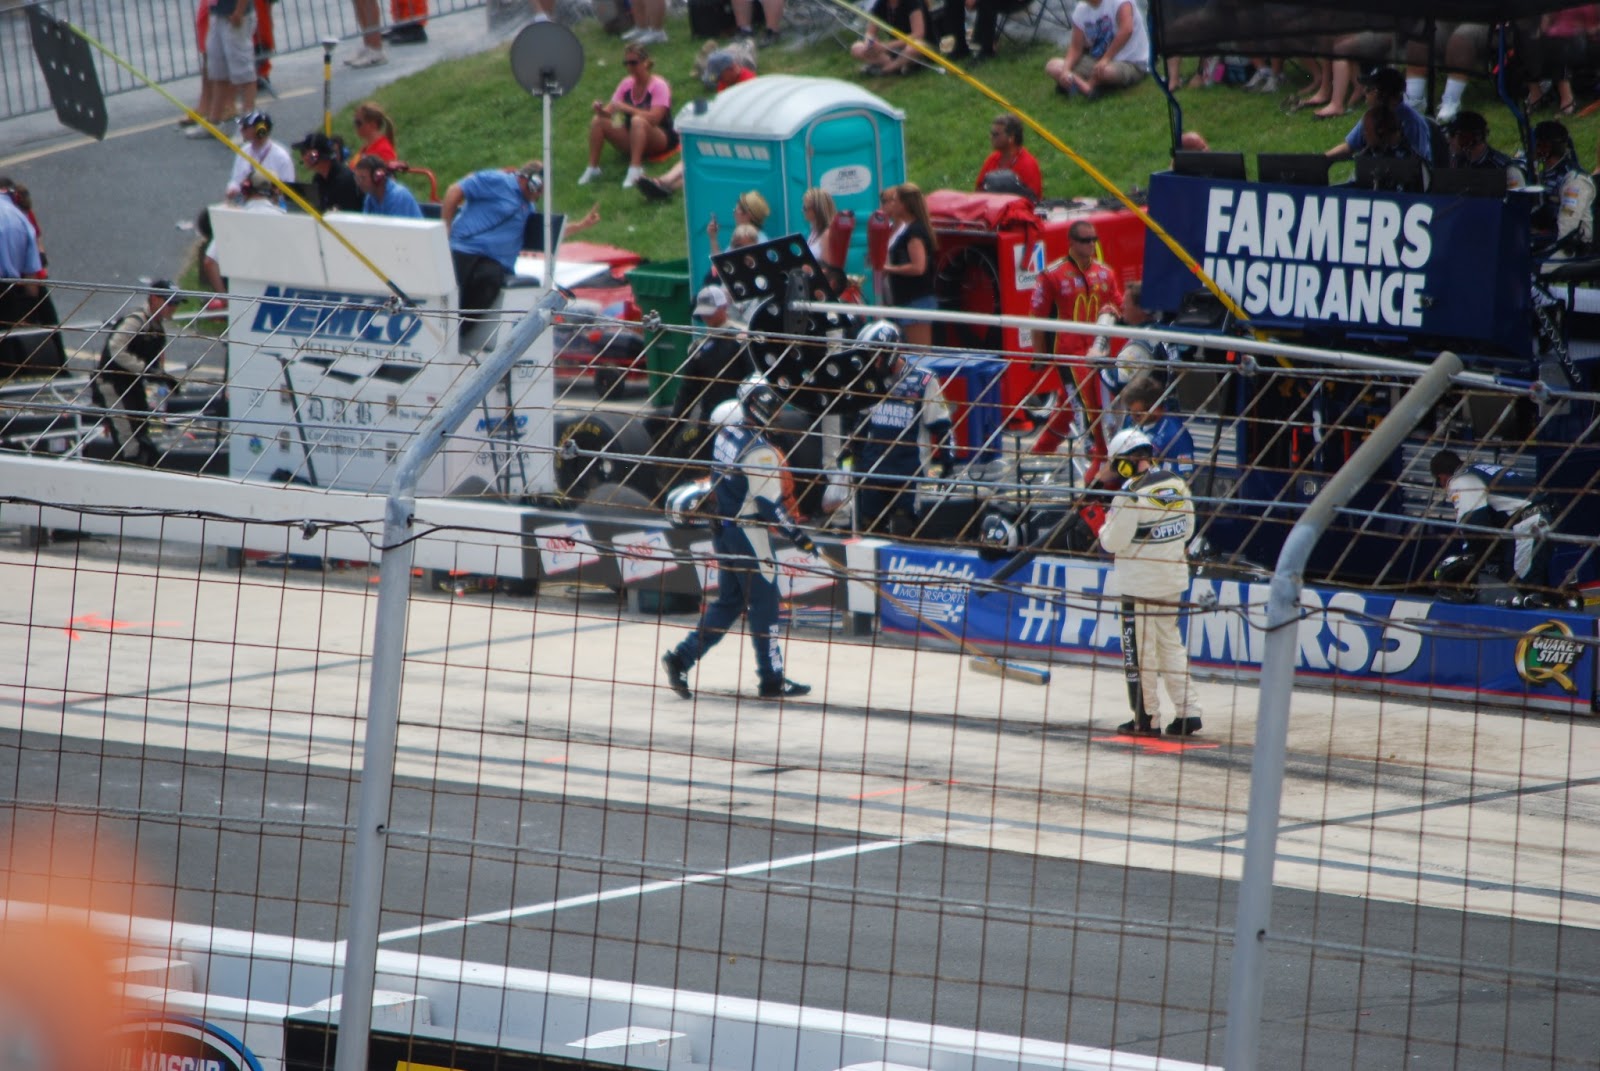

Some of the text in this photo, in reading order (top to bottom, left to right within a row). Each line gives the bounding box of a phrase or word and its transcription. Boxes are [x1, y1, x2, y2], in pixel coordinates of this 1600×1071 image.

[1205, 187, 1433, 269] FARMERS
[1202, 257, 1426, 327] INSURANCE
[899, 588, 967, 605] MOTORSPORTS
[1122, 627, 1135, 667] Sprint
[1532, 636, 1585, 653] QUAKER
[1536, 650, 1576, 665] STATE
